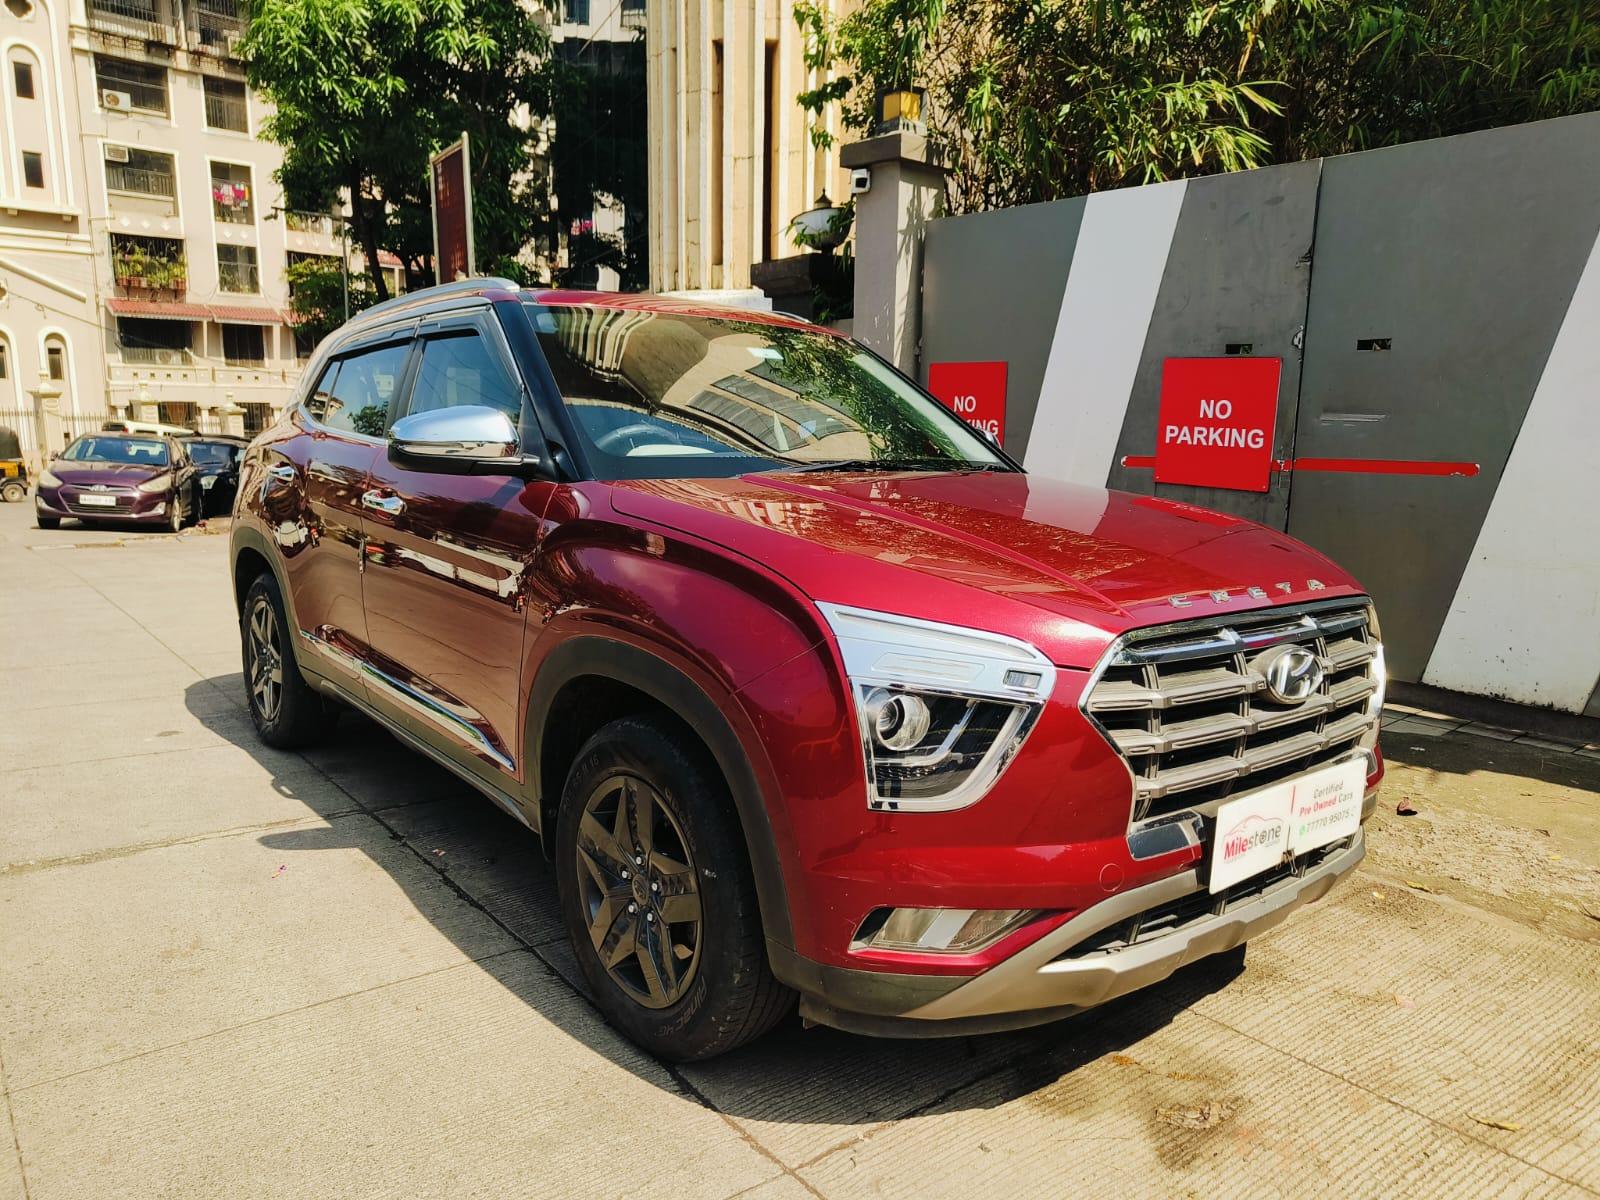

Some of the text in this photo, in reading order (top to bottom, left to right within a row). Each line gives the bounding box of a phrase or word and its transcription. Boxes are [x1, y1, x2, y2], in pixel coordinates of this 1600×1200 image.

[953, 395, 977, 413] NO
[1199, 399, 1233, 420] NO
[1164, 425, 1265, 450] PARKING
[1167, 579, 1326, 608] CRETA
[1313, 779, 1344, 799] Certified
[1299, 791, 1353, 817] Pre Owned Cars
[1223, 825, 1282, 860] Milestone
